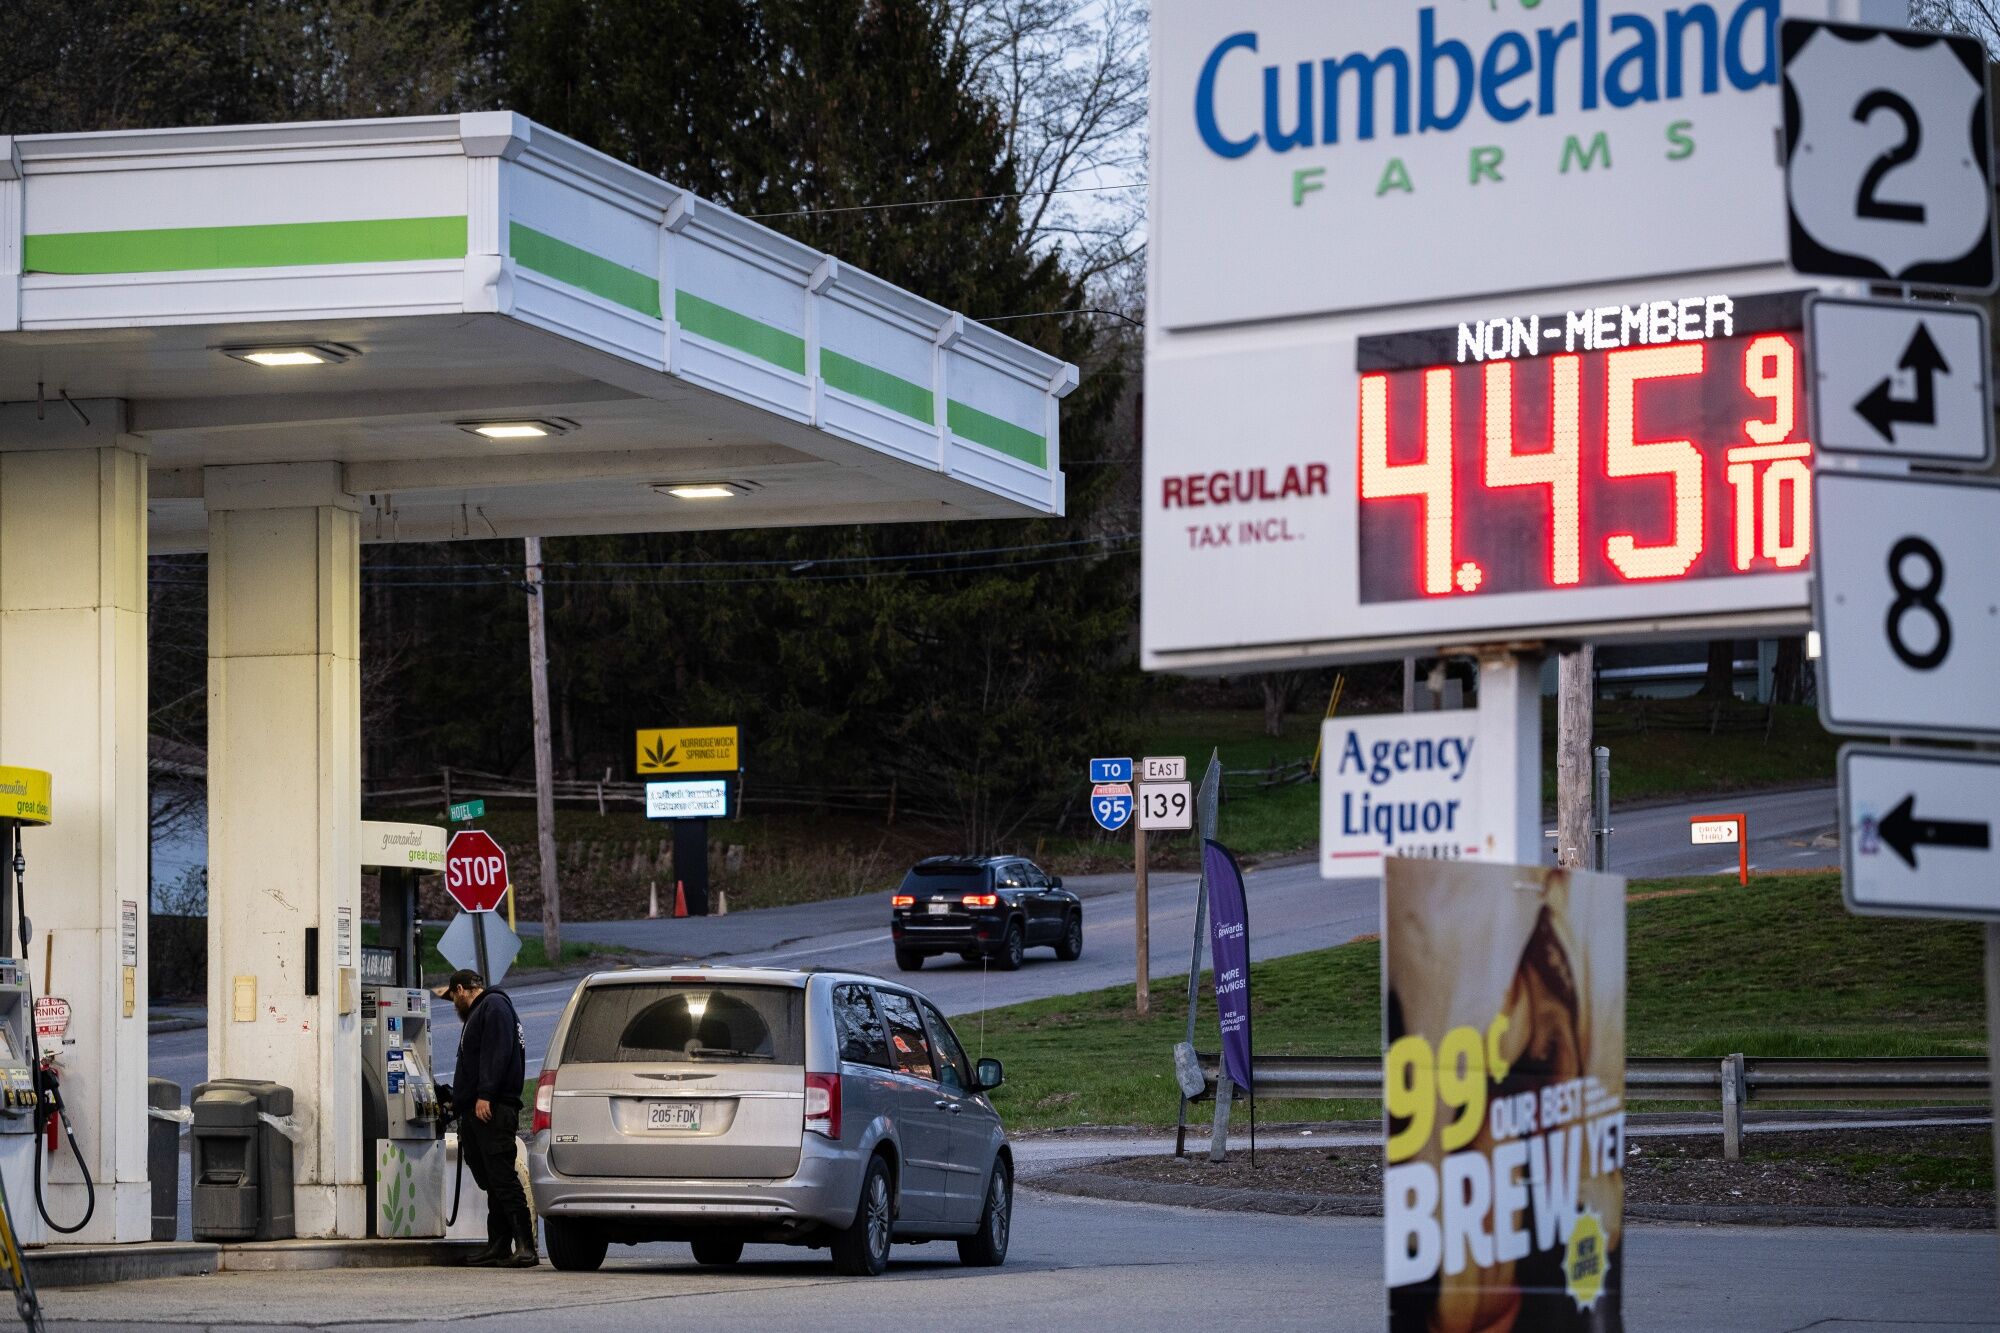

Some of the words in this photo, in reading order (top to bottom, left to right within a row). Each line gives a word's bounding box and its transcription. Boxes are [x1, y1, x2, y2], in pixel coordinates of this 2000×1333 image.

[1195, 0, 1781, 159] Cumberland
[1293, 119, 1695, 206] FARMS
[1852, 87, 1926, 222] 2
[1457, 295, 1734, 362] NON-MEMBER
[1746, 335, 1794, 444] 9
[1361, 343, 1704, 594] 4.45
[1163, 462, 1328, 509] REGULAR
[1727, 459, 1811, 571] 10
[1187, 524, 1231, 548] TAX
[1239, 517, 1305, 544] INCL.
[1886, 535, 1953, 670] 8
[680, 737, 735, 748] NORRIDGEWOCK
[686, 749, 715, 759] SPRINGS
[717, 748, 730, 758] LLC
[1339, 729, 1474, 785] Agency
[1102, 763, 1121, 777] TO
[1150, 762, 1179, 776] EAST
[17, 800, 35, 815] great
[450, 805, 472, 819] HOTEL
[477, 807, 483, 815] ST
[1098, 800, 1126, 822] 95
[1143, 793, 1186, 818] 139
[1343, 792, 1461, 846] Liquor
[381, 829, 422, 849] guaranteed
[408, 849, 427, 862] great
[449, 856, 502, 887] STOP
[1219, 922, 1243, 938] Rewards
[1221, 968, 1240, 982] MORE
[36, 1007, 65, 1016] RNING
[1490, 1092, 1537, 1140] OUR
[1540, 1078, 1583, 1128] BEST
[1386, 1124, 1582, 1288] BREW
[1586, 1112, 1624, 1178] YET
